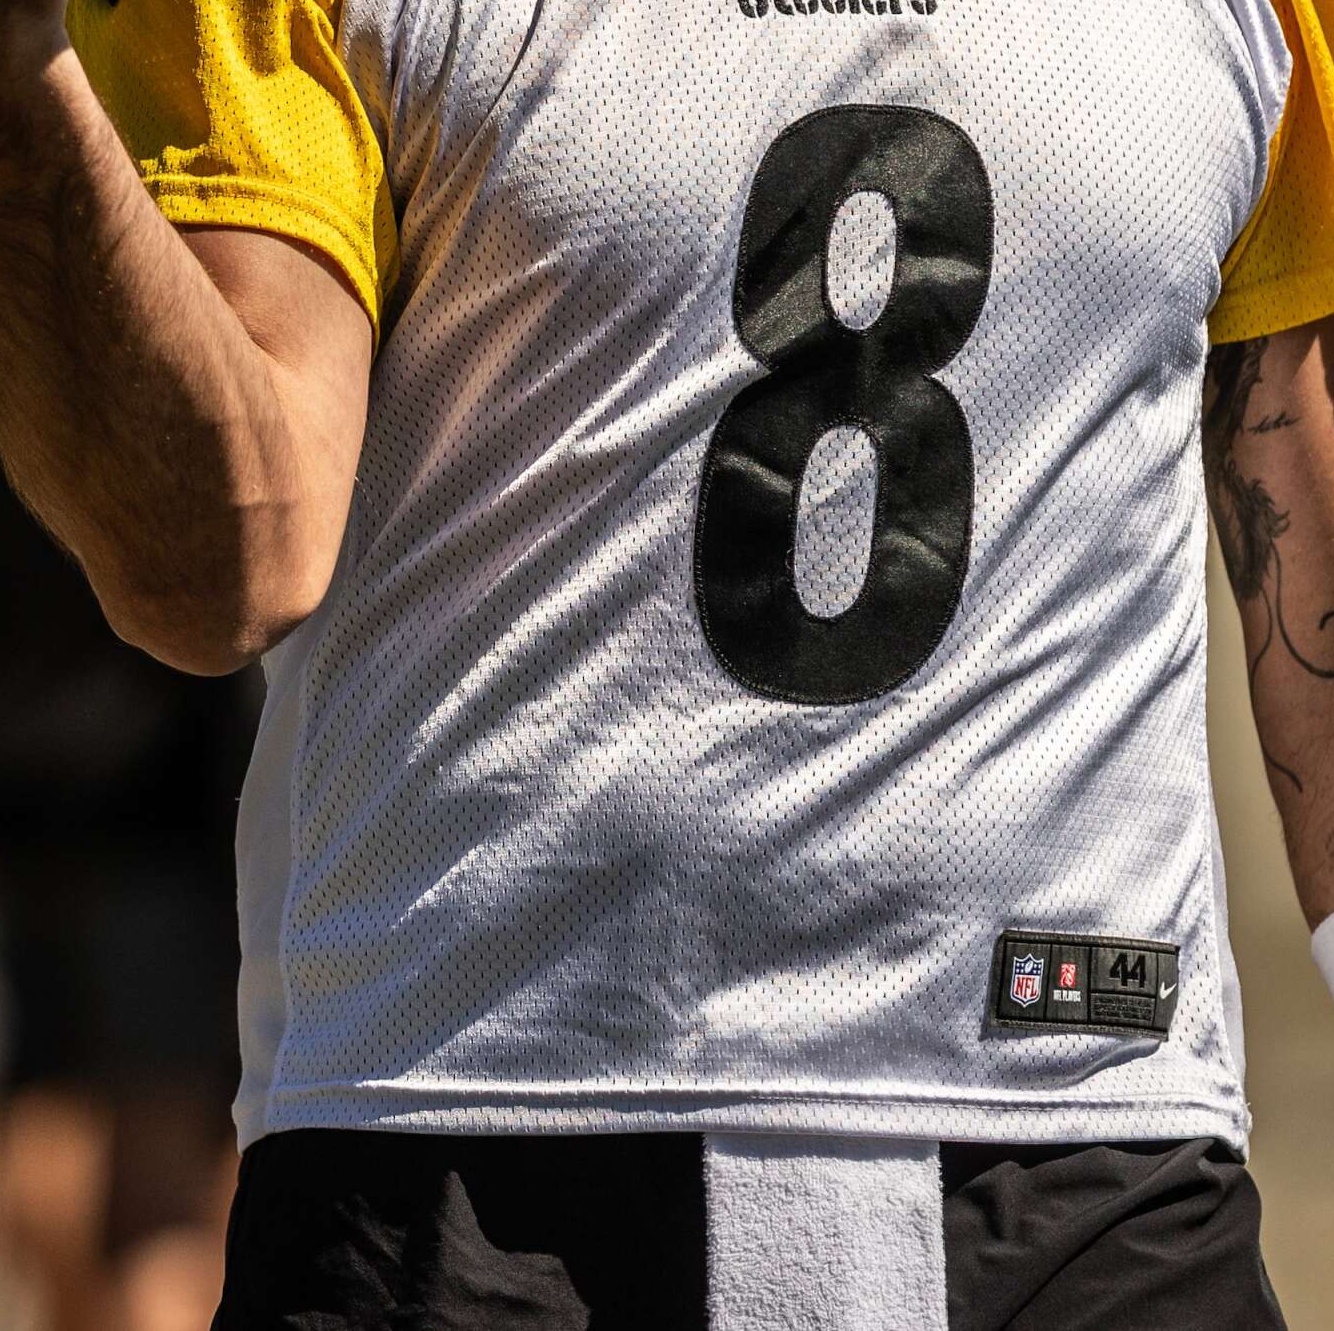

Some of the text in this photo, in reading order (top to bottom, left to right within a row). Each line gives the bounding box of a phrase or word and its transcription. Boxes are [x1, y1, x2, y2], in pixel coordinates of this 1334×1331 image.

[693, 103, 995, 707] 8
[1014, 975, 1037, 998] NFL
[1108, 952, 1147, 989] 44
